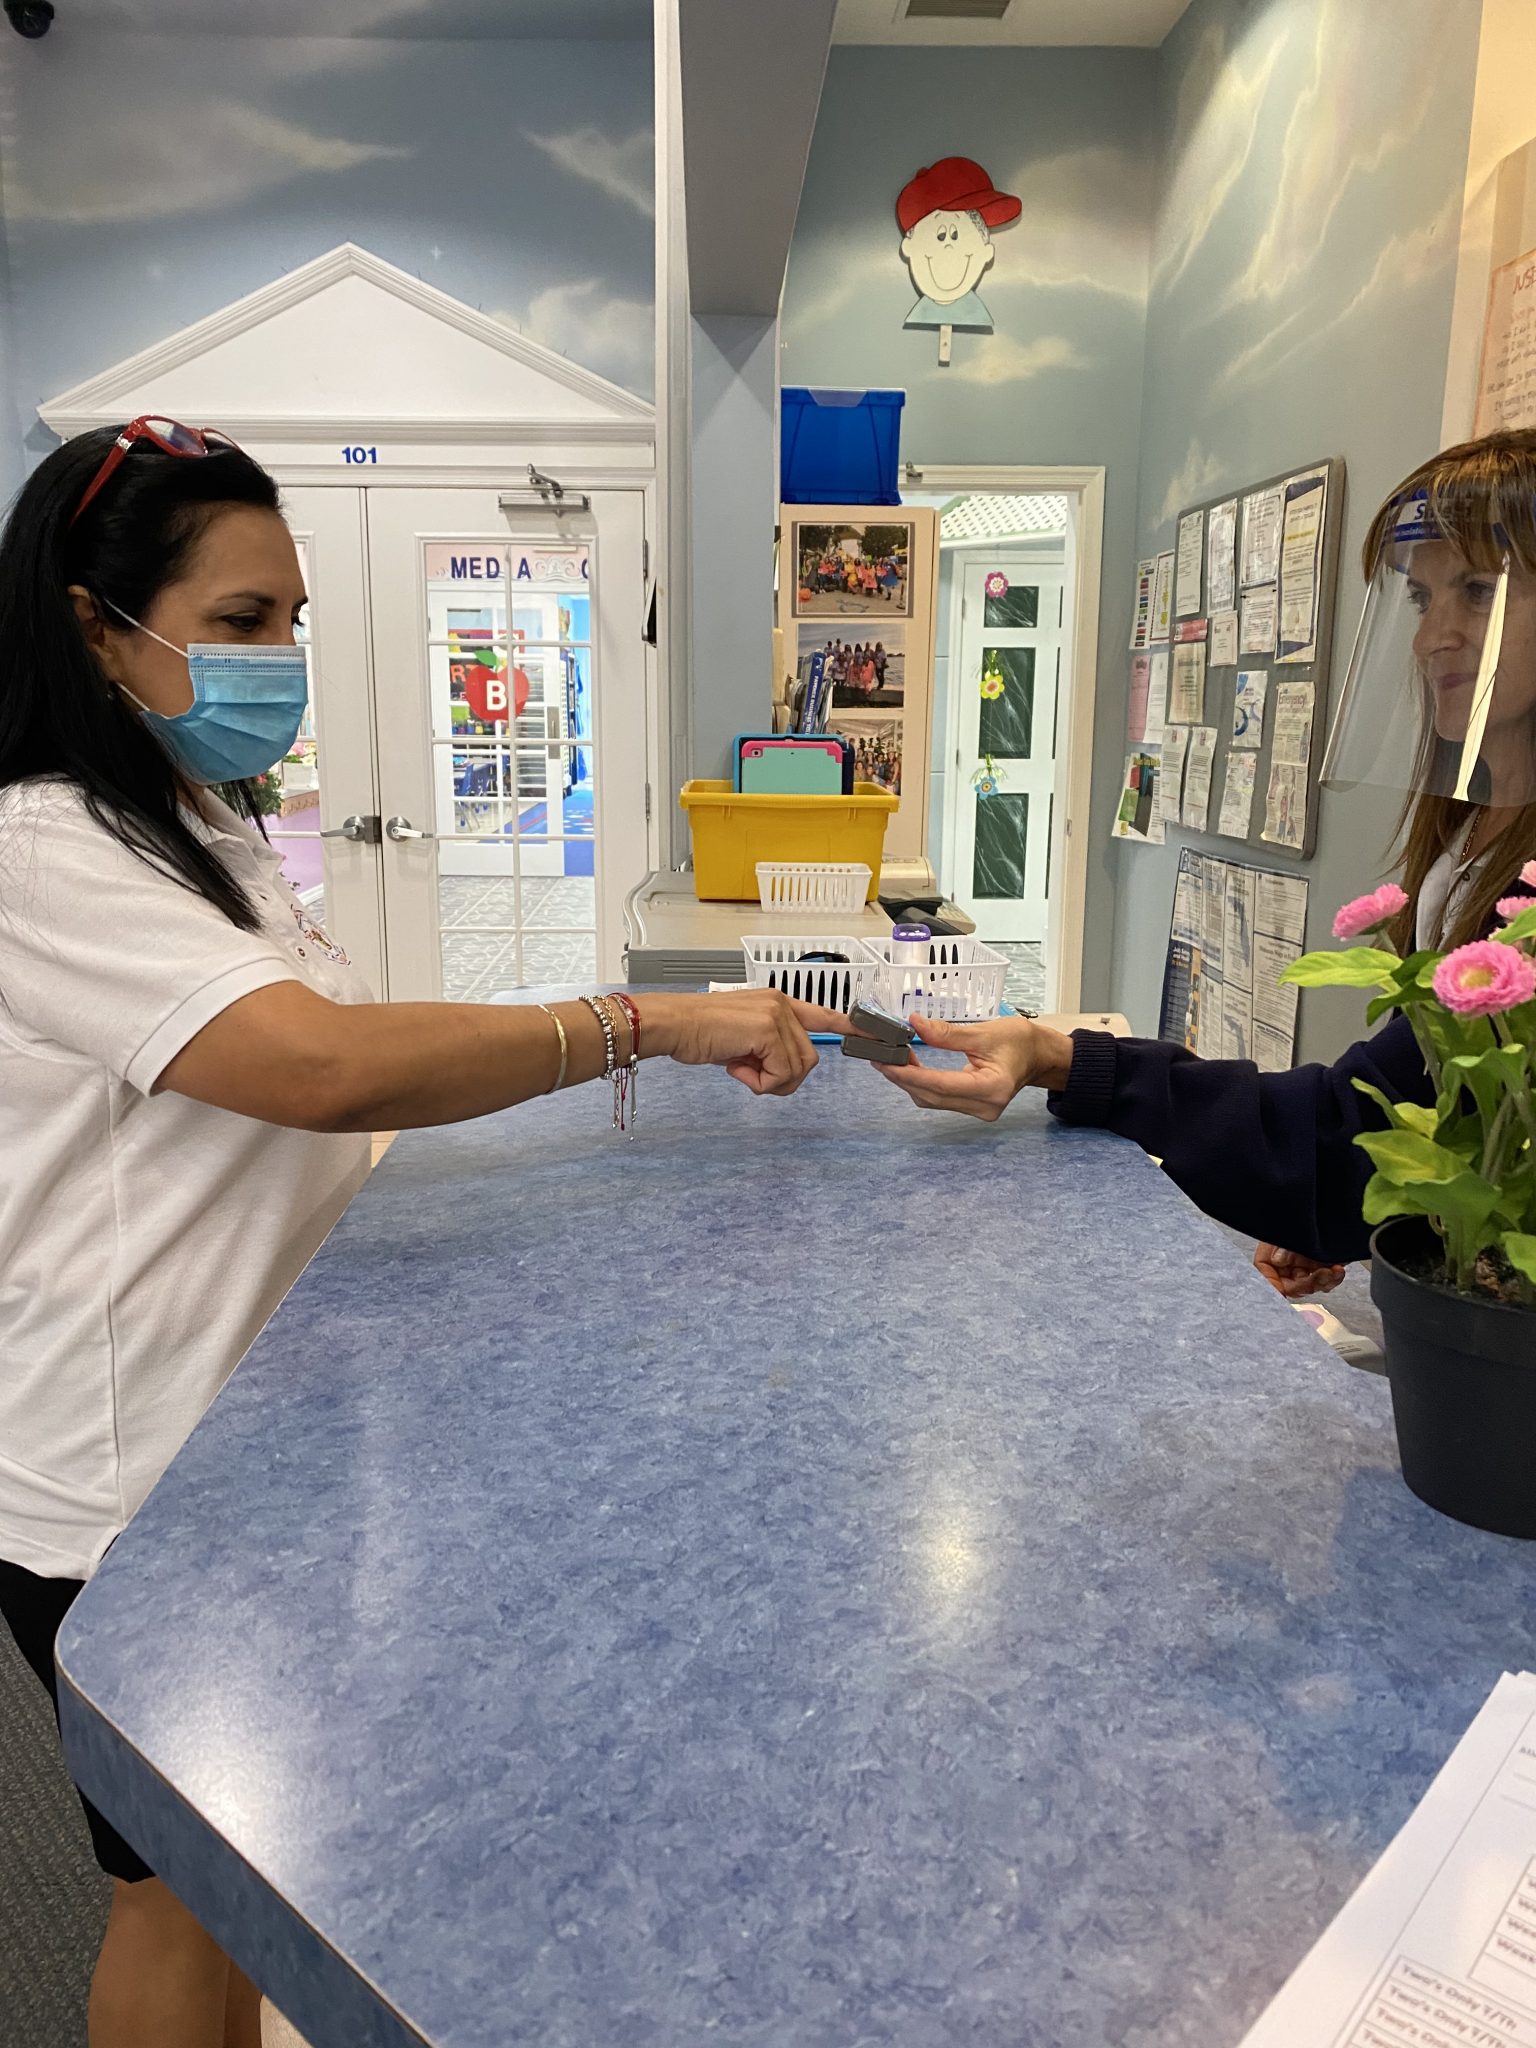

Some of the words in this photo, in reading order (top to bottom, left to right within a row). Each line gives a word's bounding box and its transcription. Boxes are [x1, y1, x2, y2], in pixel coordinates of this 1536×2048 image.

[341, 446, 377, 464] 101
[450, 556, 531, 579] MEDA
[486, 679, 507, 711] B
[1390, 1984, 1431, 2013] Two's
[1403, 1964, 1443, 1991] Two's
[1446, 1986, 1480, 2011] Only
